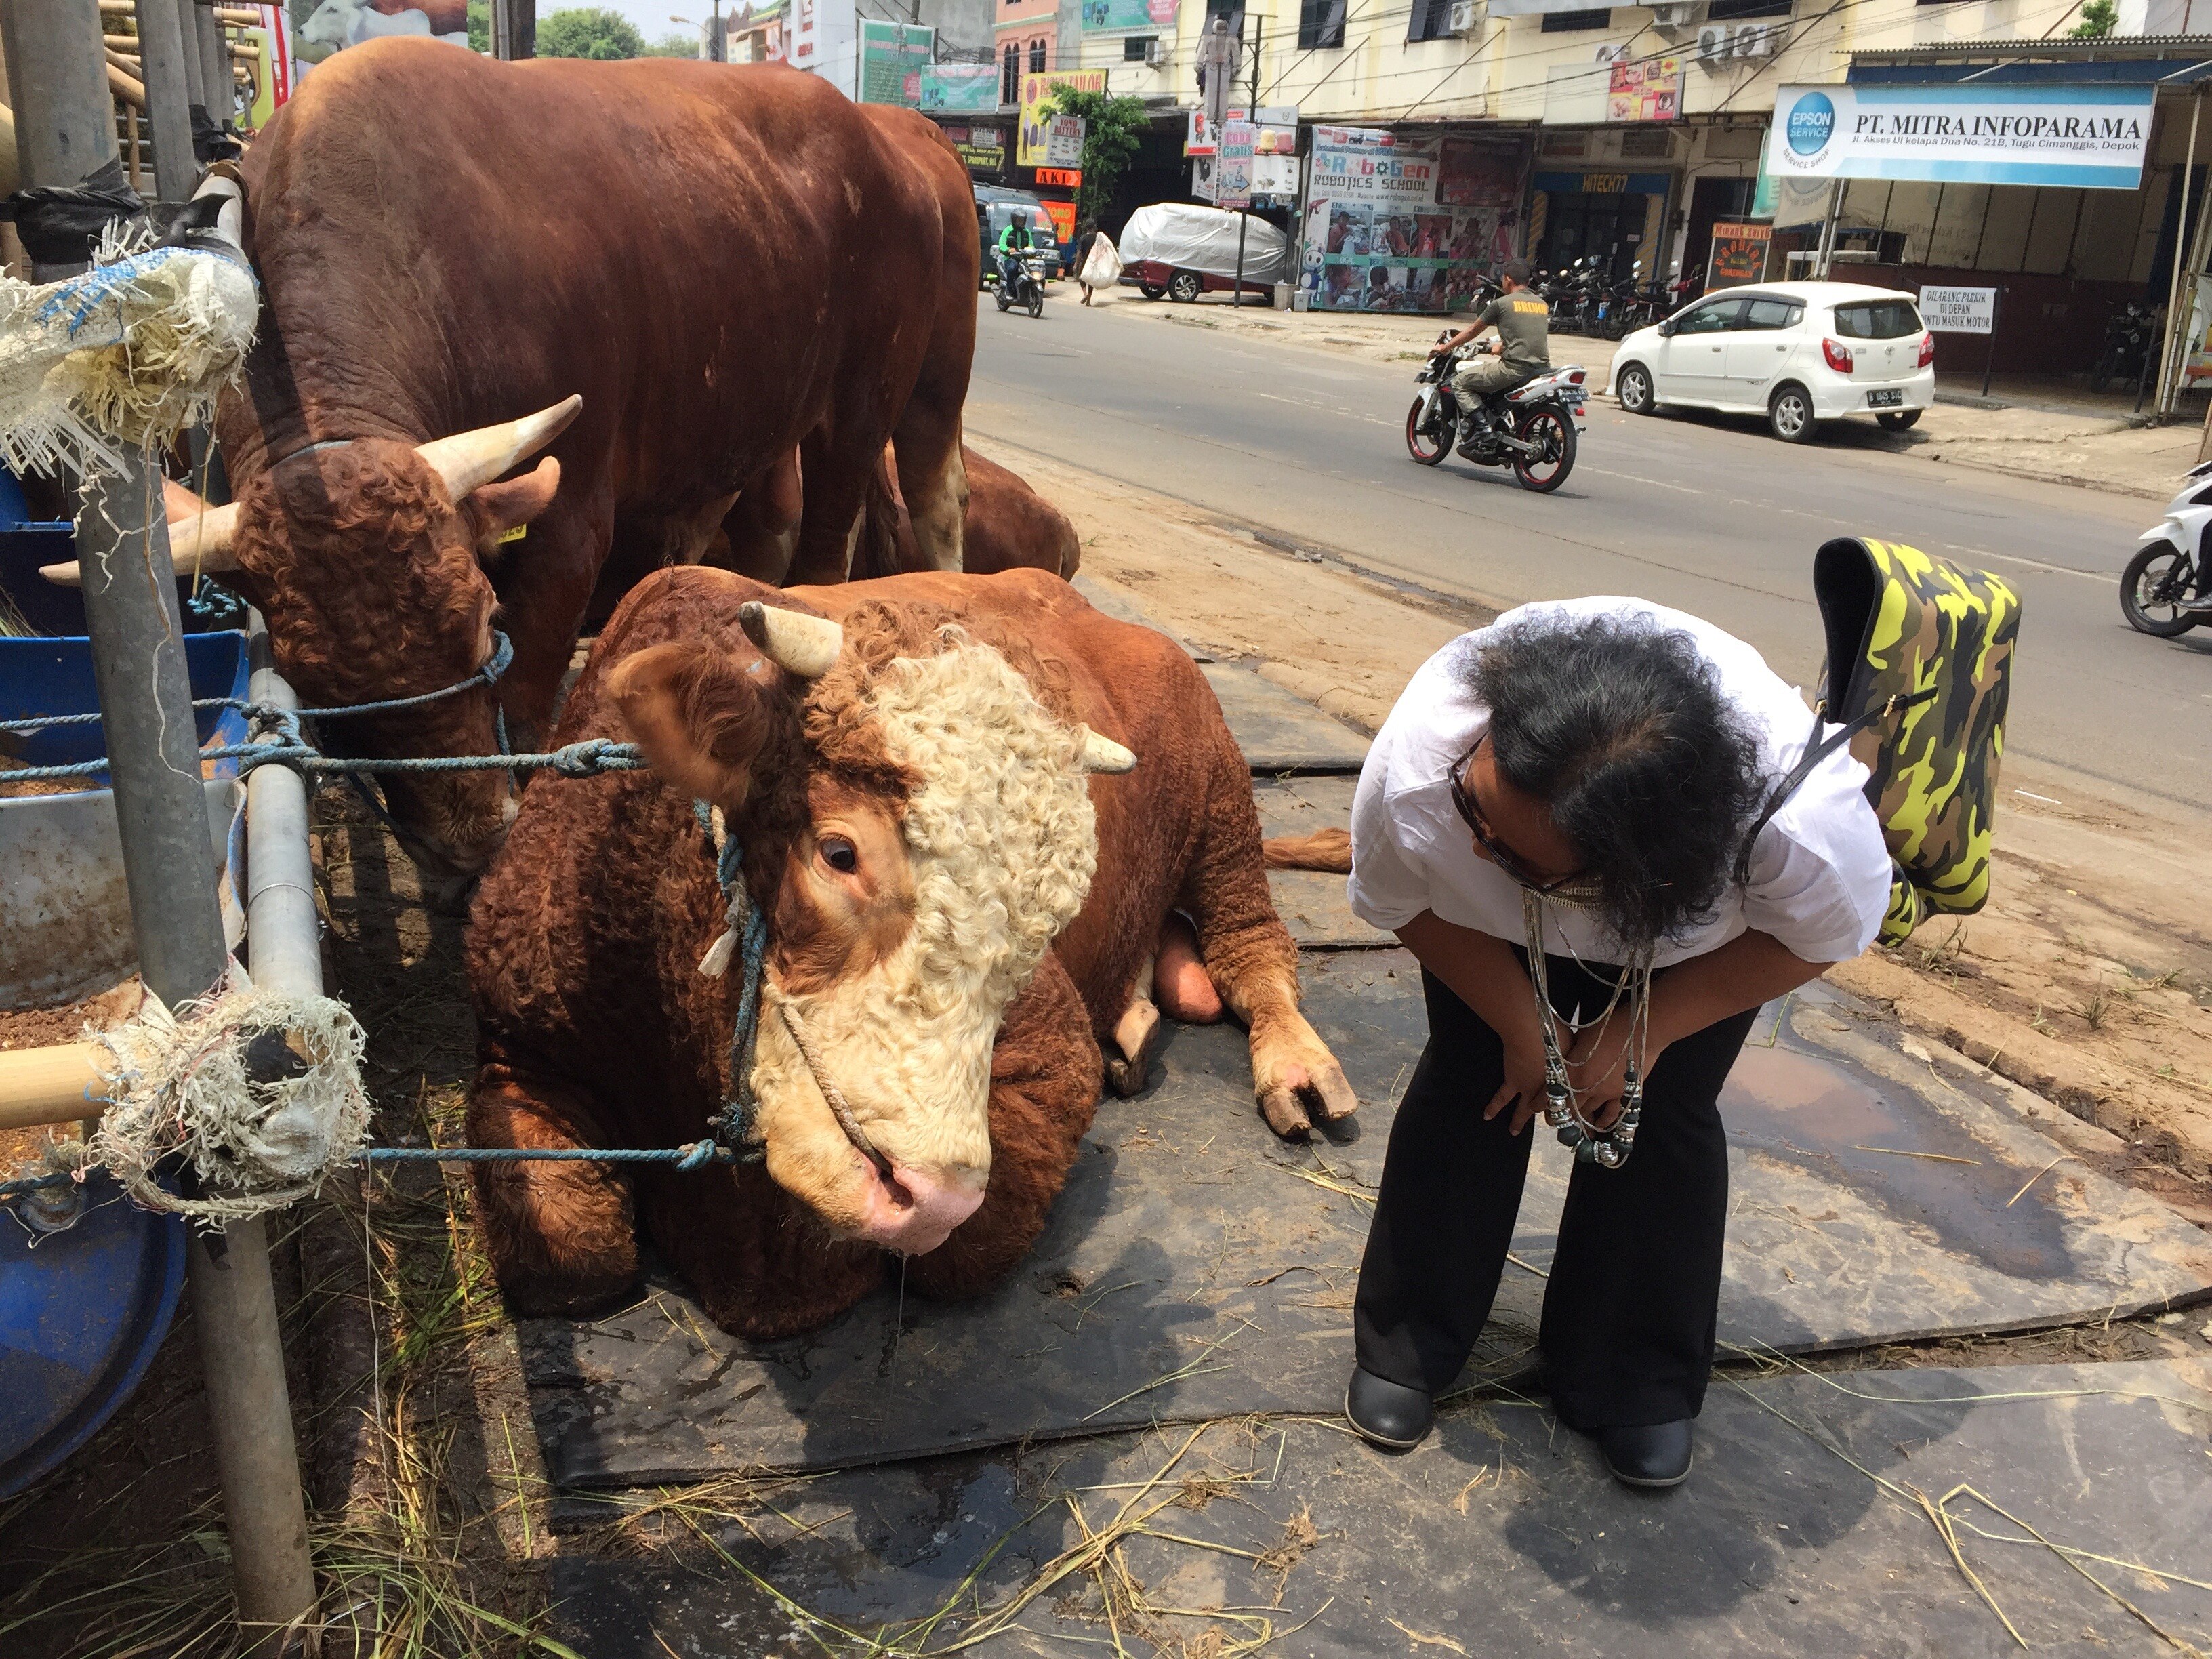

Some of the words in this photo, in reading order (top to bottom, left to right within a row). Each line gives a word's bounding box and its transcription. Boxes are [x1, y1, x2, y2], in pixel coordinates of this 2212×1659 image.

[1060, 118, 1078, 127] YONO
[1793, 112, 1831, 126] EPSON
[1790, 127, 1828, 138] SERVICE
[1854, 114, 1883, 134] PT.
[1890, 115, 1967, 136] MITRA
[1971, 115, 2143, 140] INFOPARAMA
[1864, 136, 1891, 144] Akses
[1906, 136, 1938, 146] kelapa
[1941, 137, 1961, 146] Dua
[1963, 138, 1980, 146] No.
[2011, 139, 2035, 148] Tugu
[2038, 139, 2098, 150] Cimanggis,
[2102, 140, 2140, 152] Depok
[1784, 148, 1808, 168] SERVICE
[1811, 148, 1829, 167] SHOP
[1040, 171, 1067, 184] AKI
[1314, 174, 1373, 190] ROBOTICS
[1381, 178, 1429, 192] SCHOOL
[1582, 173, 1628, 193] HITECH77
[1927, 291, 1961, 302] DILARANG
[1961, 292, 1986, 303] PARKIR
[1940, 304, 1947, 313] DI
[1949, 304, 1970, 314] DEPAN
[1942, 316, 1965, 326] MASUK
[1967, 316, 1990, 328] MOTOR
